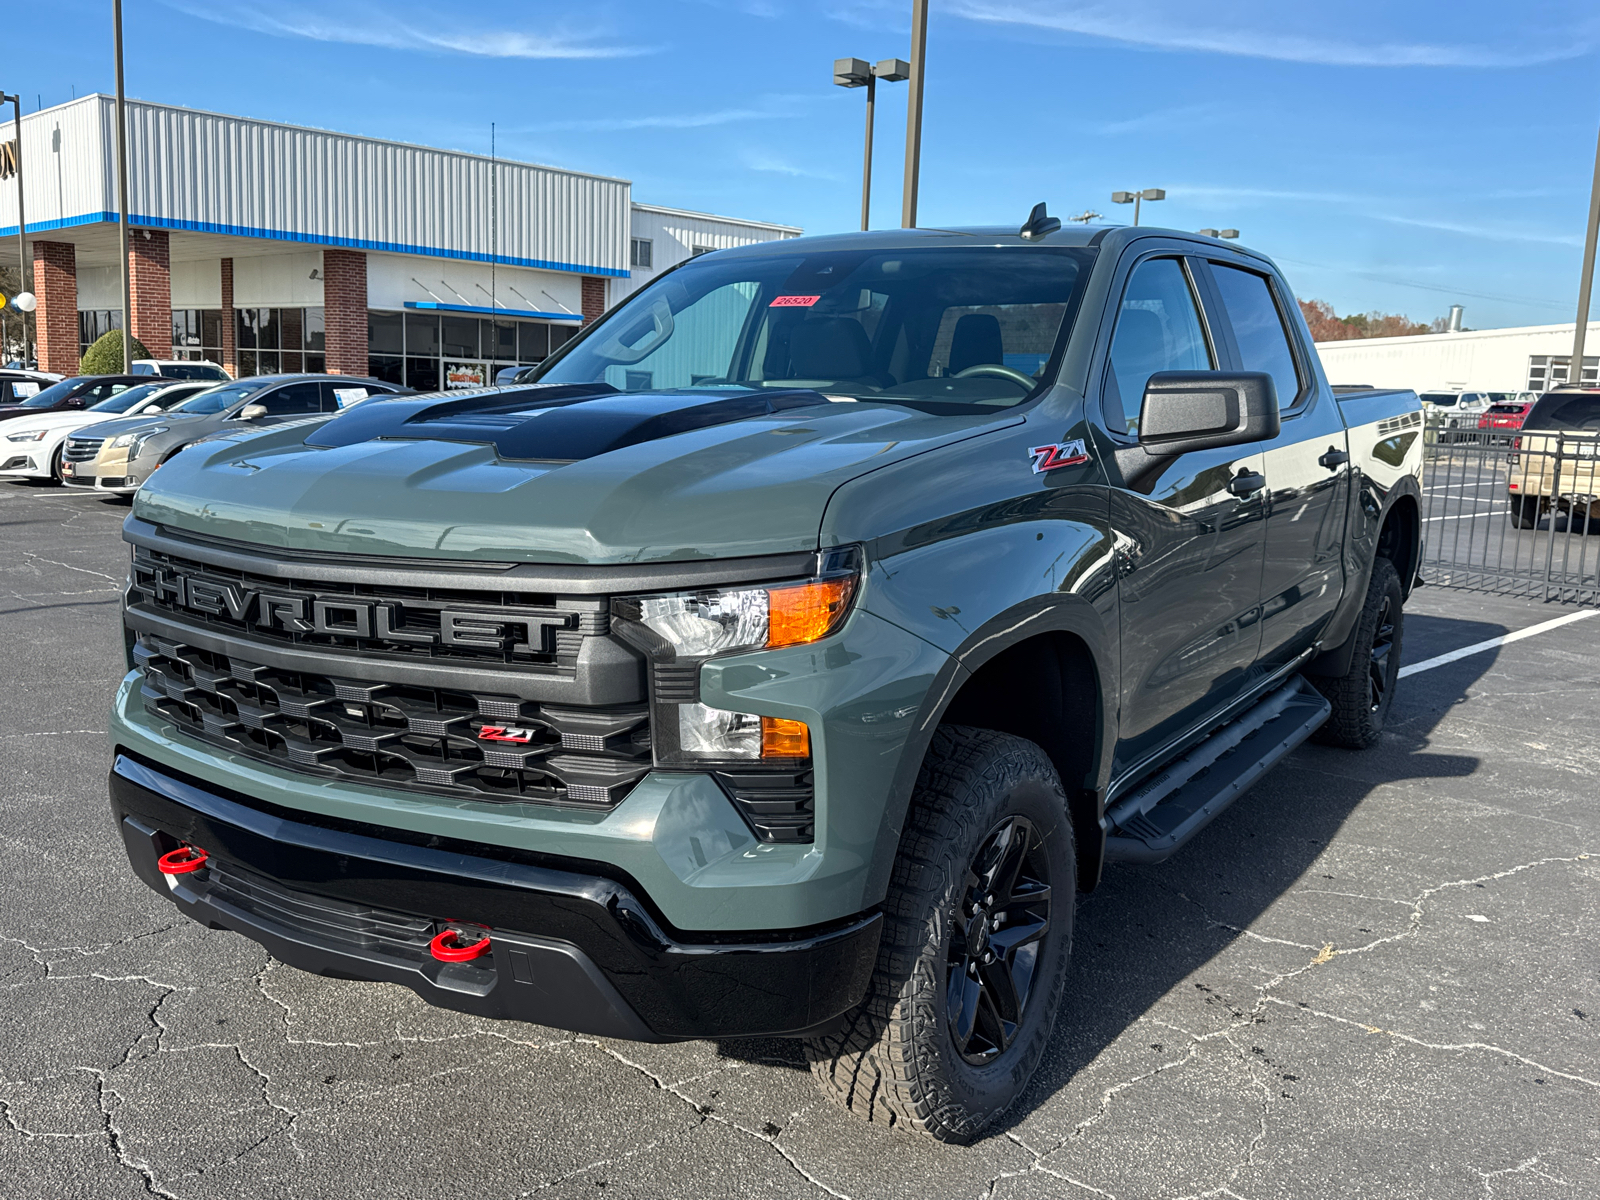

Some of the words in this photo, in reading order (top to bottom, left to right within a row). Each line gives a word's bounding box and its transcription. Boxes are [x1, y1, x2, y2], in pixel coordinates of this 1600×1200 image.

[777, 297, 812, 305] 26520
[1028, 438, 1088, 474] Z71
[130, 560, 580, 653] CHEVROLET
[478, 725, 536, 743] Z71
[1137, 774, 1171, 799] SILVERADO
